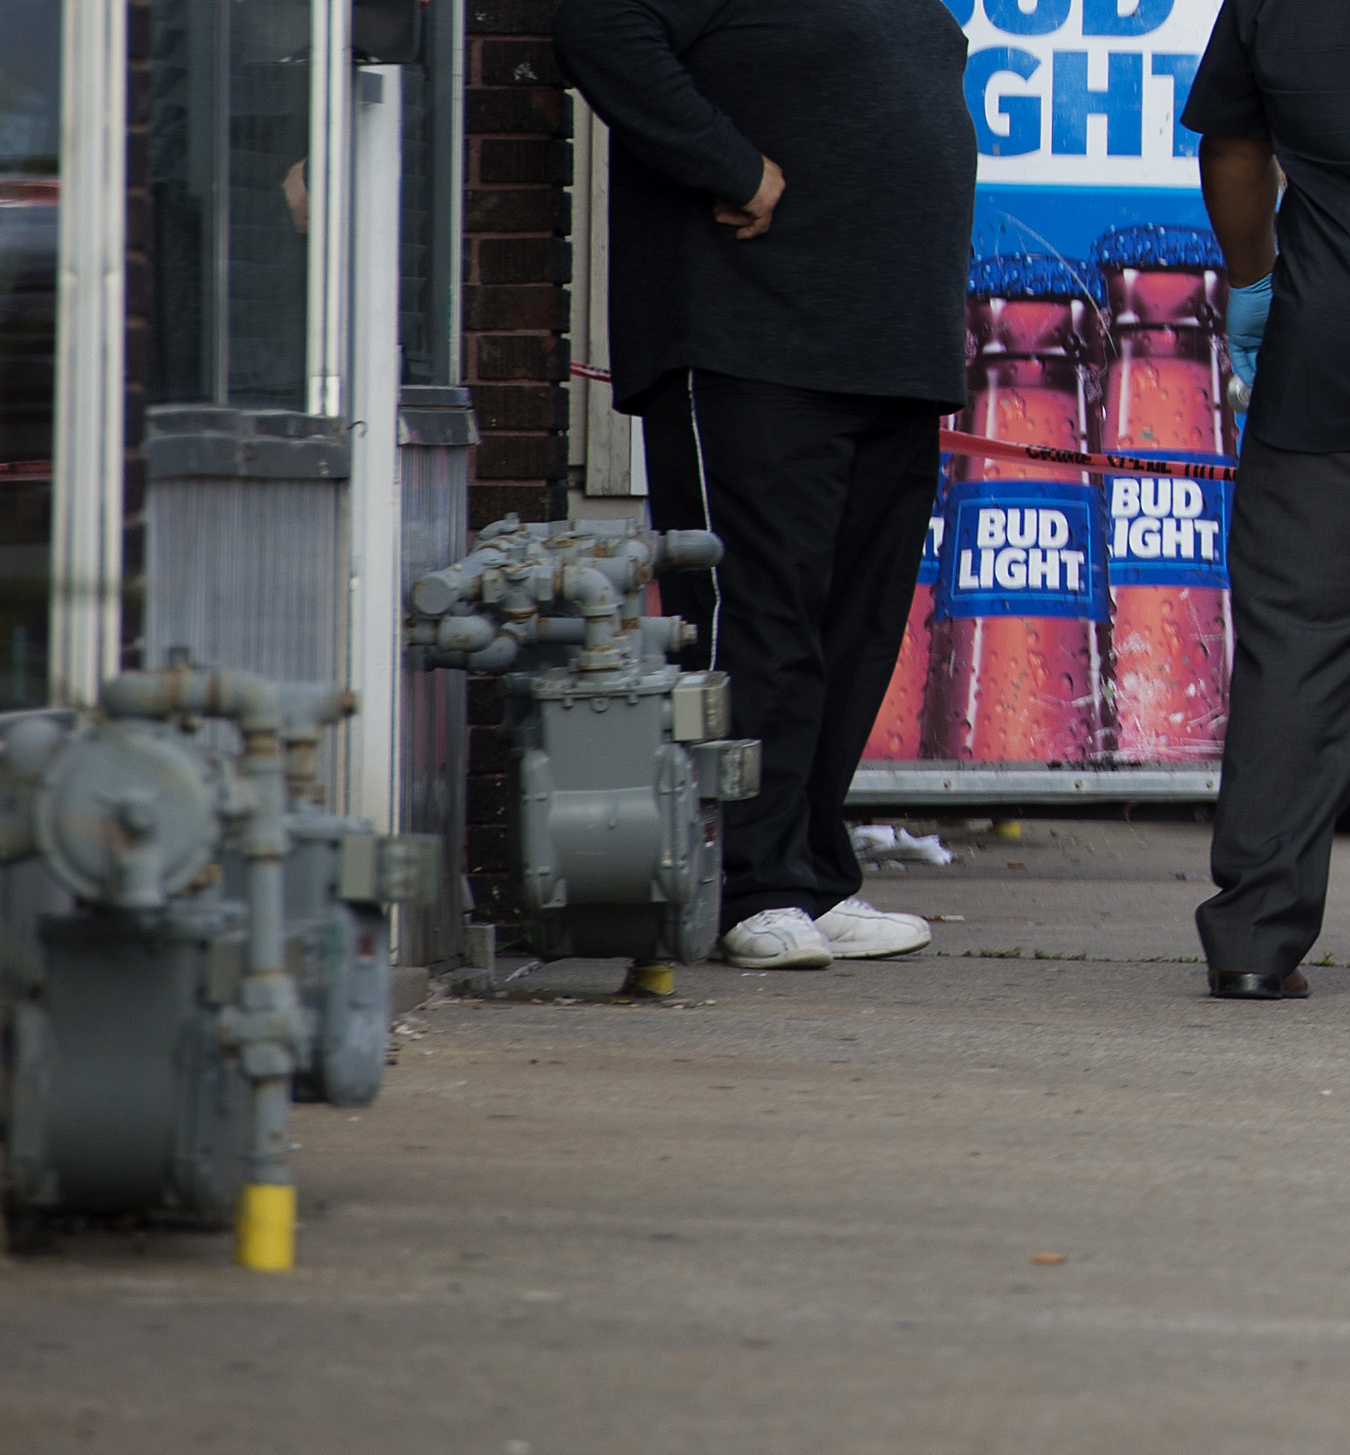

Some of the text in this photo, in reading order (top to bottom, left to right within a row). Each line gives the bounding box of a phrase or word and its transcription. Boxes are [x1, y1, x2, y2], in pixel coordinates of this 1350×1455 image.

[964, 44, 1205, 159] GHT
[1111, 478, 1203, 519] BUD
[977, 508, 1070, 549] BUD
[1108, 517, 1220, 561] IGHT
[958, 547, 1084, 591] LIGHT
